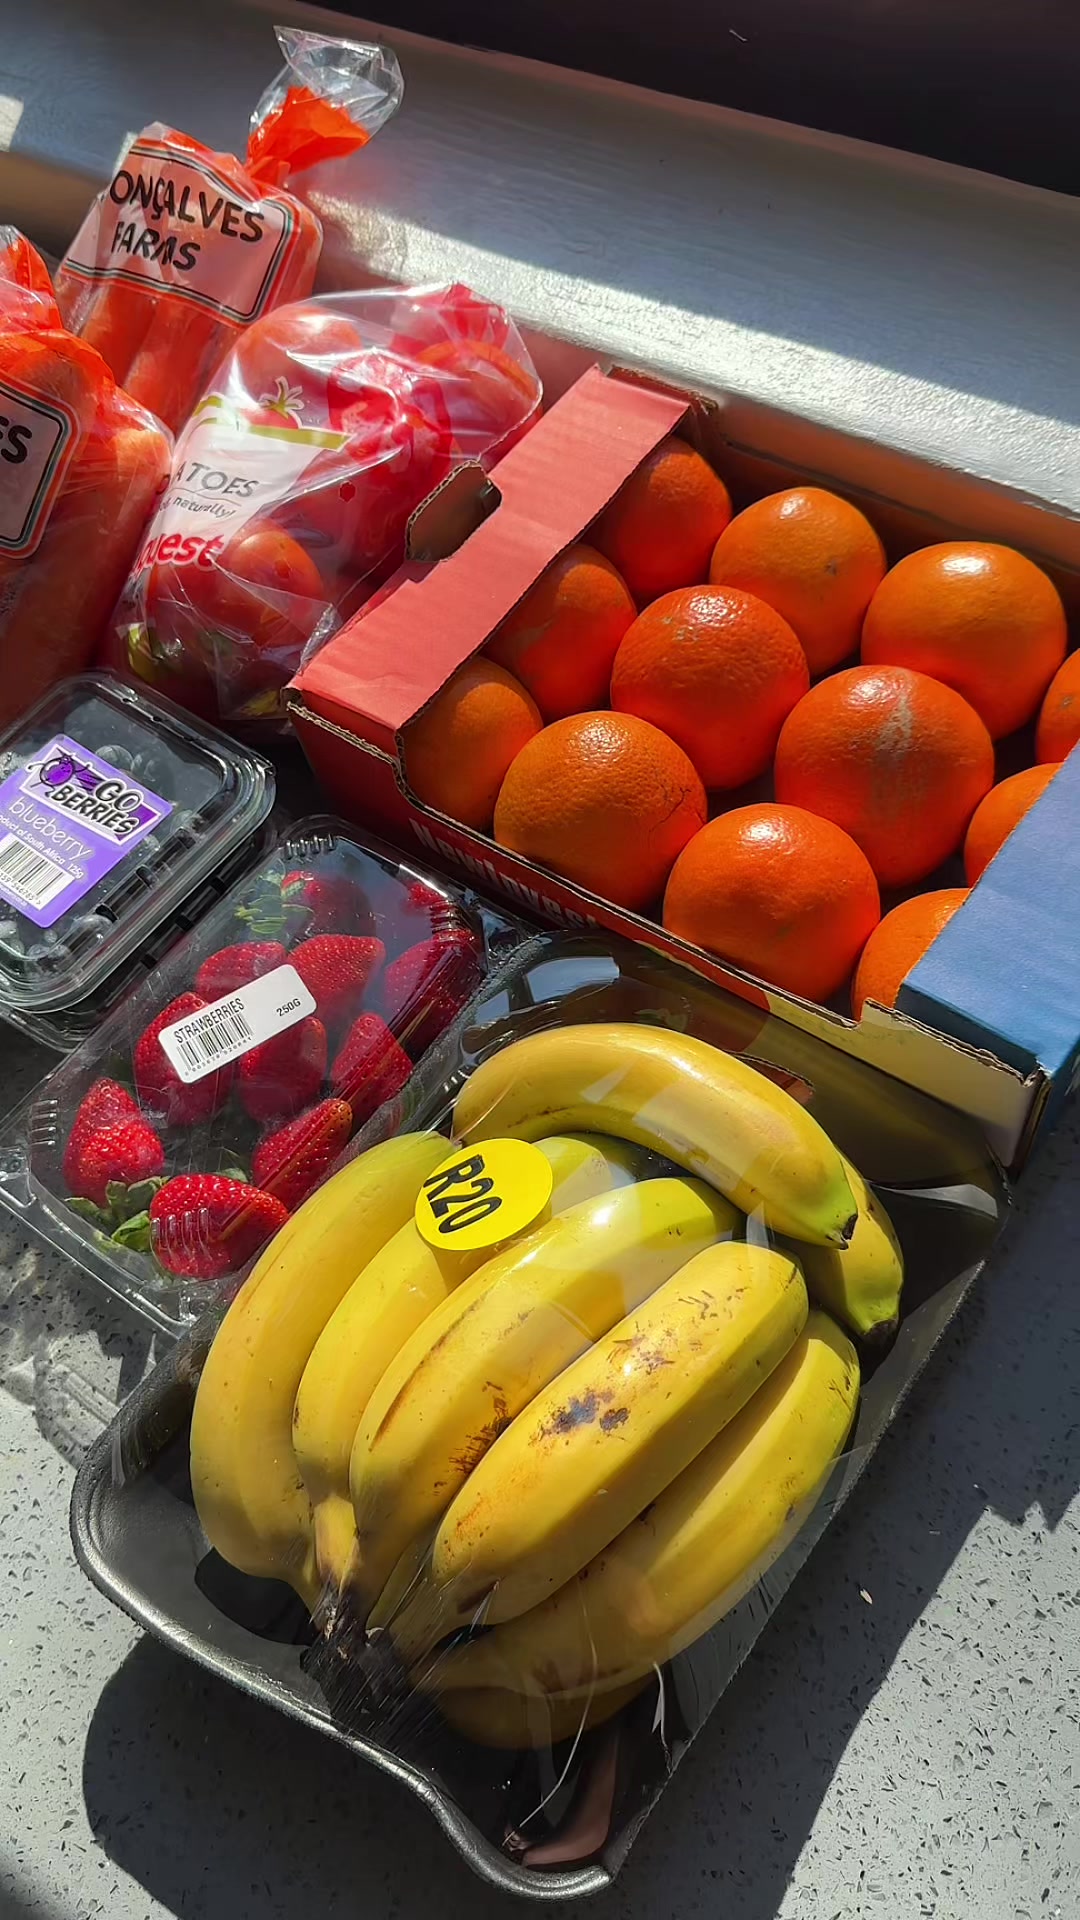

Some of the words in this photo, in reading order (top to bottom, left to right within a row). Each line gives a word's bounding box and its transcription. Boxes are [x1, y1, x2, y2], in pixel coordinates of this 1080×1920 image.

[107, 169, 264, 242] ONÇALVES
[51, 785, 138, 833] BERRIES
[95, 780, 142, 811] GO
[9, 797, 92, 860] blueberry
[23, 833, 45, 851] South
[43, 847, 66, 864] Africa
[67, 863, 84, 879] 125g
[173, 998, 245, 1044] STRAWBERRIES
[276, 998, 301, 1017] 250G
[422, 1154, 503, 1234] R20
